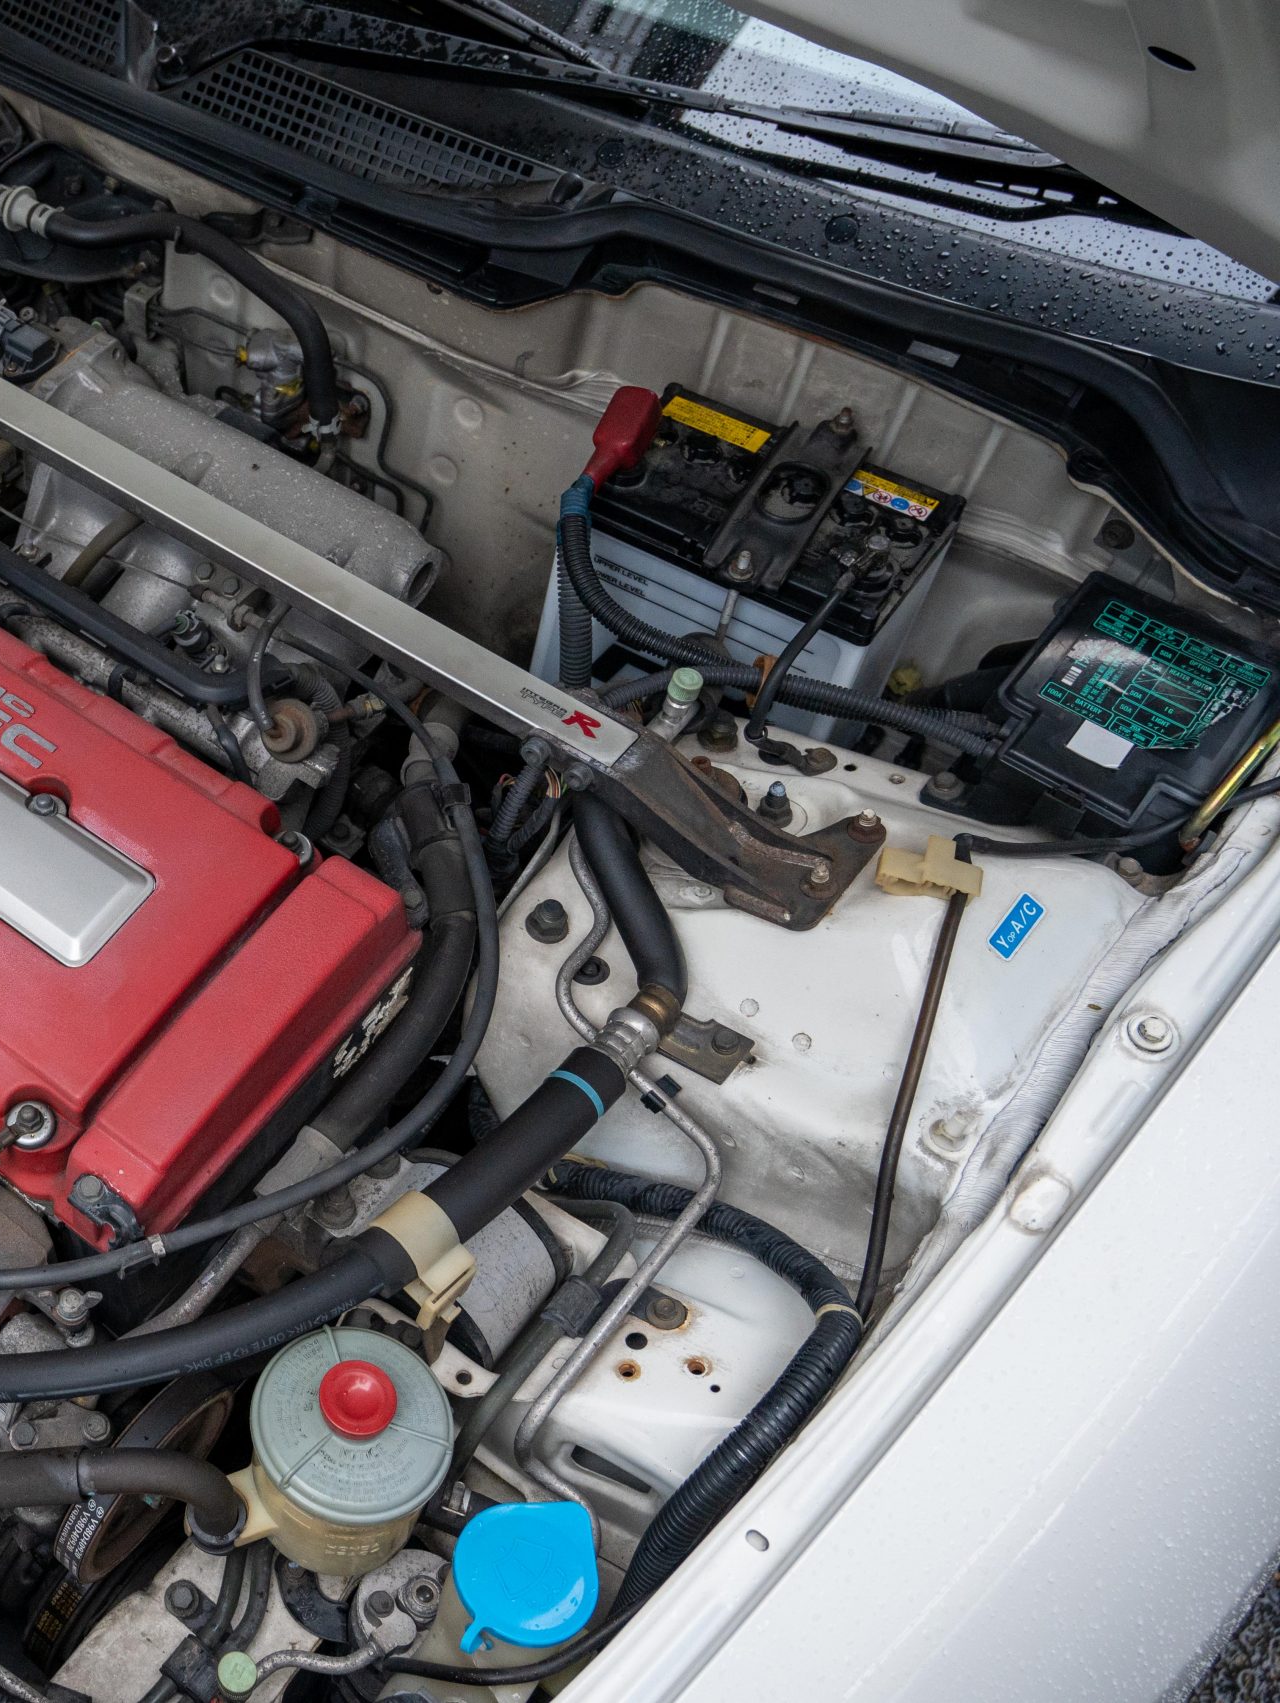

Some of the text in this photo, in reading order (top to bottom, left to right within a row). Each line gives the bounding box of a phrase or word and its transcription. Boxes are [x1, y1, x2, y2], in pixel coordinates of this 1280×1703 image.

[593, 556, 648, 585] UPPER LEVEL
[618, 580, 645, 596] LEVEL
[1188, 659, 1212, 673] OPTION
[1168, 668, 1189, 681] HEATER
[1191, 679, 1212, 692] MOTOR
[1046, 687, 1102, 714] 100A BATTERY
[561, 709, 602, 739] R
[1150, 715, 1169, 727] LIGHT
[73, 1518, 98, 1559] V98D40920
